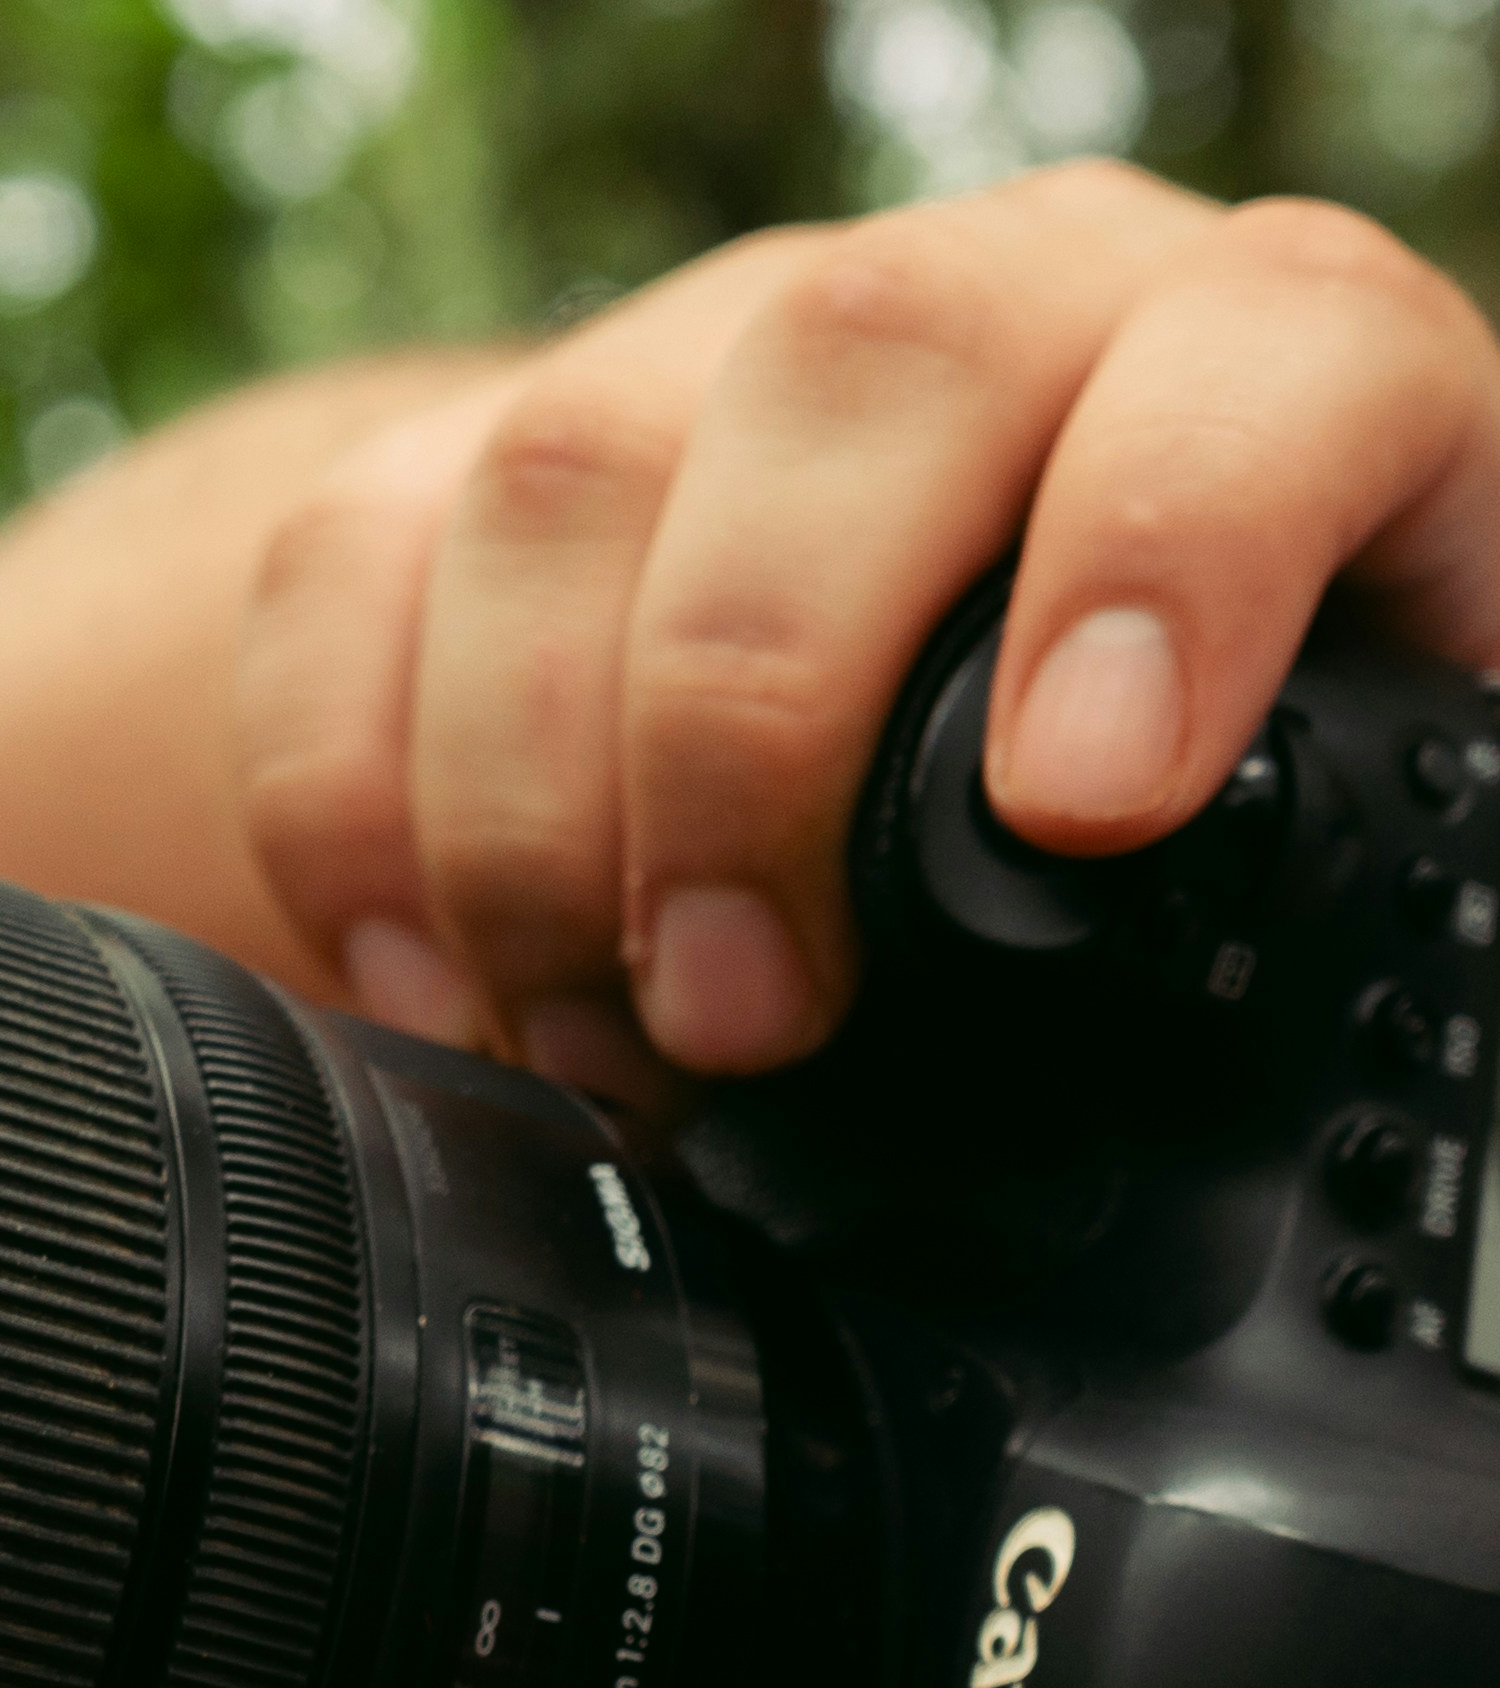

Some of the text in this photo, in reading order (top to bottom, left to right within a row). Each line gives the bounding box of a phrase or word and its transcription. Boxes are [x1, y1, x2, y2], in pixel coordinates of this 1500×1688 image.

[1421, 1136, 1468, 1239] DRIVE
[630, 1506, 668, 1566] DG
[615, 1573, 660, 1663] 1:2.8
